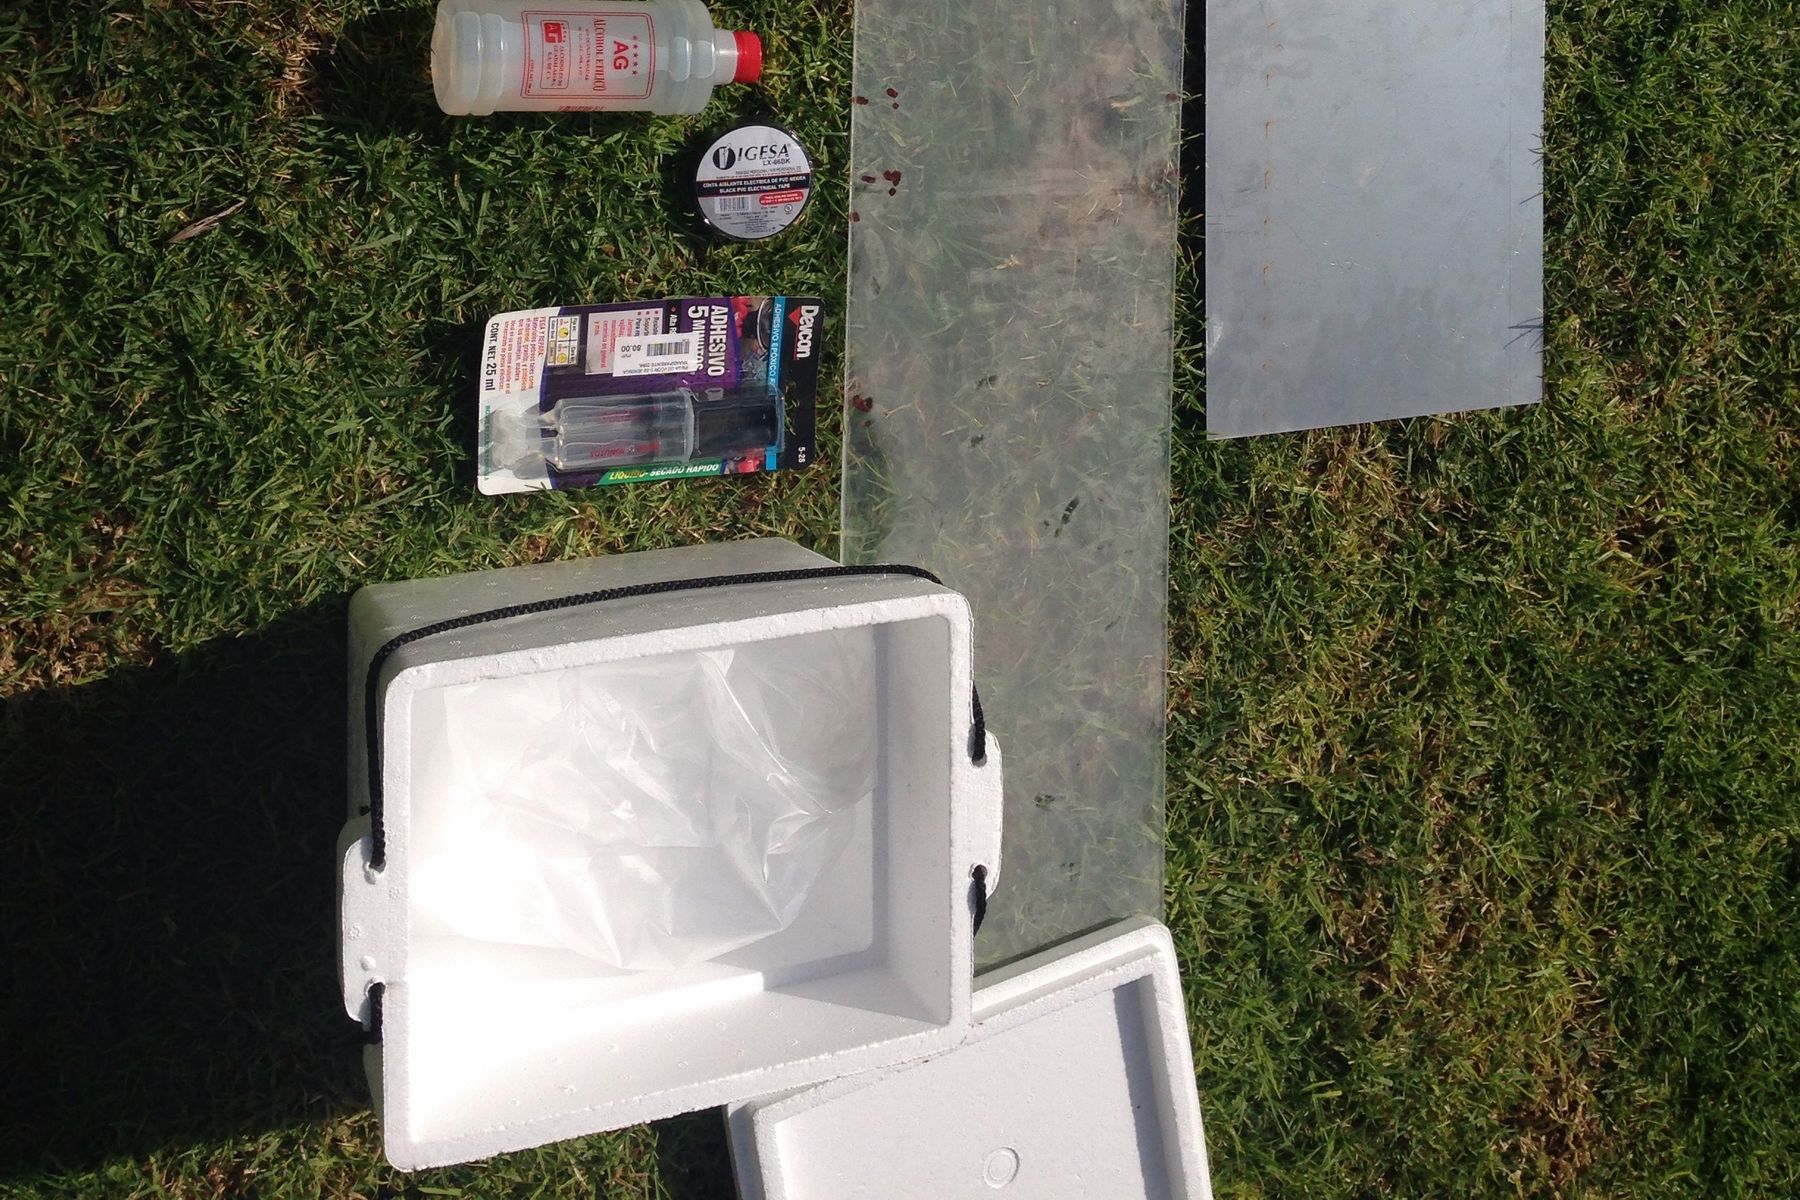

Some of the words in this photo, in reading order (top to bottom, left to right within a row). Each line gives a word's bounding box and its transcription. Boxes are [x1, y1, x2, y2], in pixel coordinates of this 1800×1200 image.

[592, 18, 606, 56] ALCOHOL
[614, 41, 629, 70] AG
[592, 58, 606, 91] ETILICO
[738, 144, 789, 162] IGESA
[669, 314, 678, 326] Alta
[688, 306, 709, 318] 5
[772, 303, 782, 341] ADHESIVO
[490, 323, 499, 343] CONT.
[707, 306, 728, 376] ADHESIVO
[797, 306, 819, 358] Devcon
[488, 345, 496, 361] NET.
[486, 363, 497, 375] 25
[485, 379, 495, 391] ml
[798, 447, 806, 463] 5-28
[650, 467, 685, 476] SECADO
